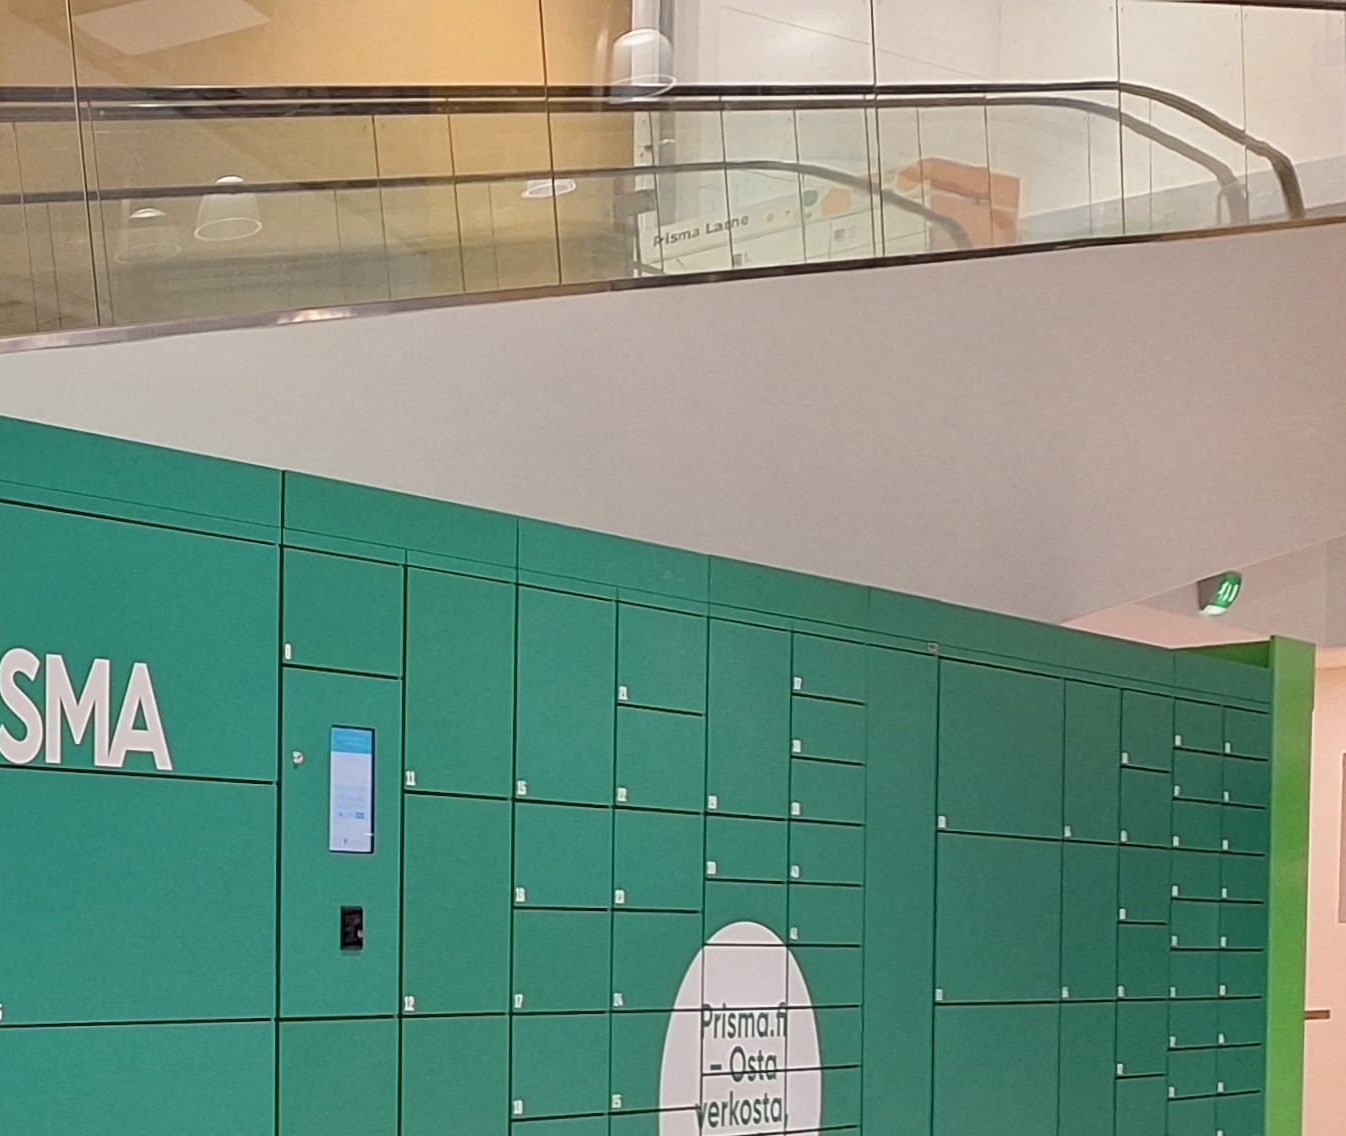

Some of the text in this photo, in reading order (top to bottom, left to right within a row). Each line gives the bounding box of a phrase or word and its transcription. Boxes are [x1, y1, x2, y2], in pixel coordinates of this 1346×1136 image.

[653, 227, 700, 248] Prisma
[284, 643, 292, 660] 8
[405, 770, 416, 786] 11
[516, 779, 527, 796] 15
[403, 995, 415, 1012] 12
[514, 993, 524, 1009] 17
[701, 1001, 787, 1039] Prisma.fi
[730, 1046, 777, 1082] Osta
[695, 1090, 788, 1129] verkosta,
